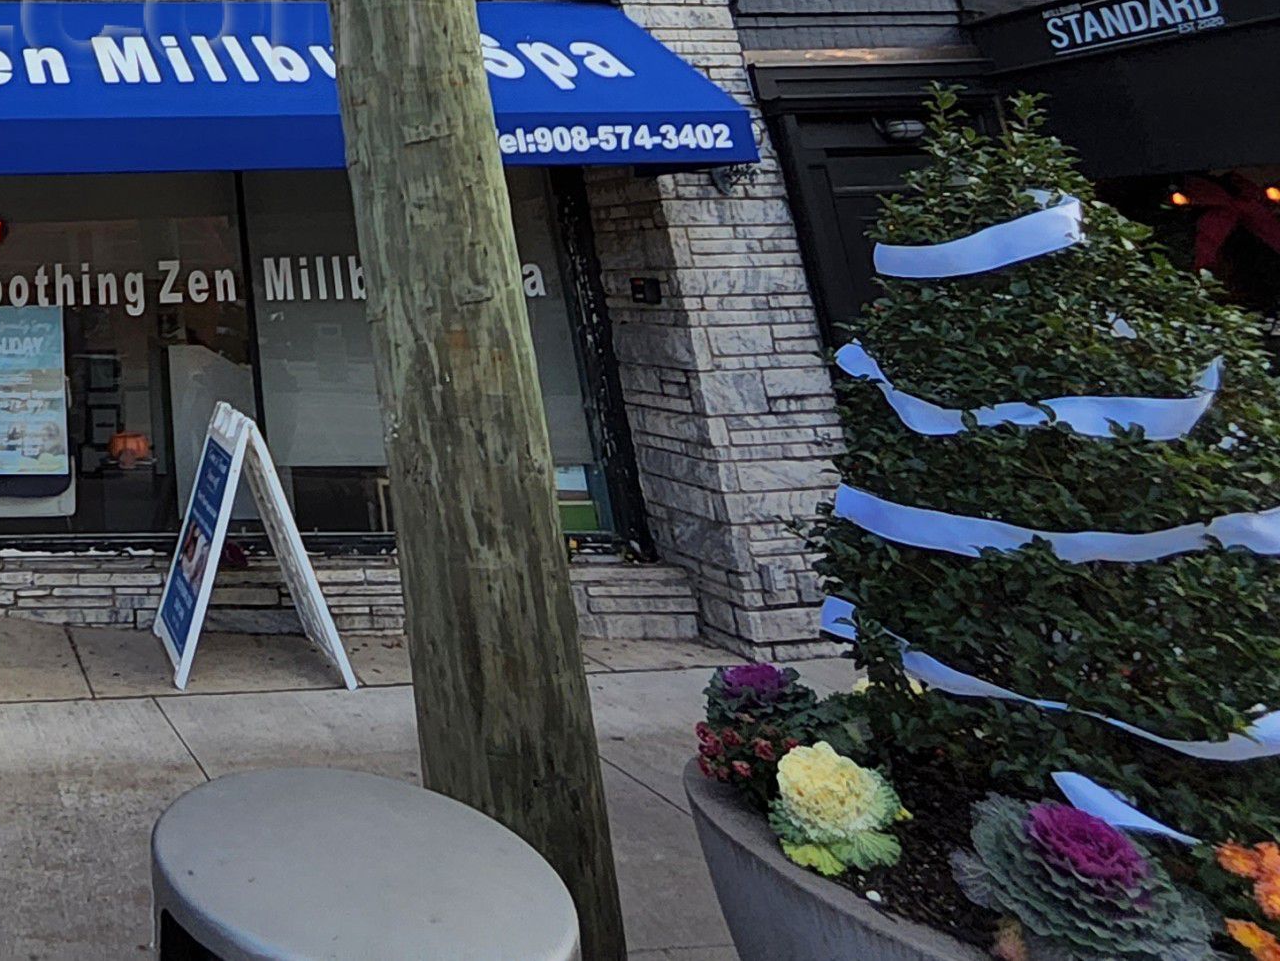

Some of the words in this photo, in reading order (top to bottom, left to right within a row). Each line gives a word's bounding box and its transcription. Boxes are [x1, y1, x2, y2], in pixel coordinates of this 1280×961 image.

[91, 35, 336, 83] Millb
[495, 124, 734, 155] el:908-574-3402
[157, 260, 237, 304] Zen
[263, 255, 366, 301] Millb
